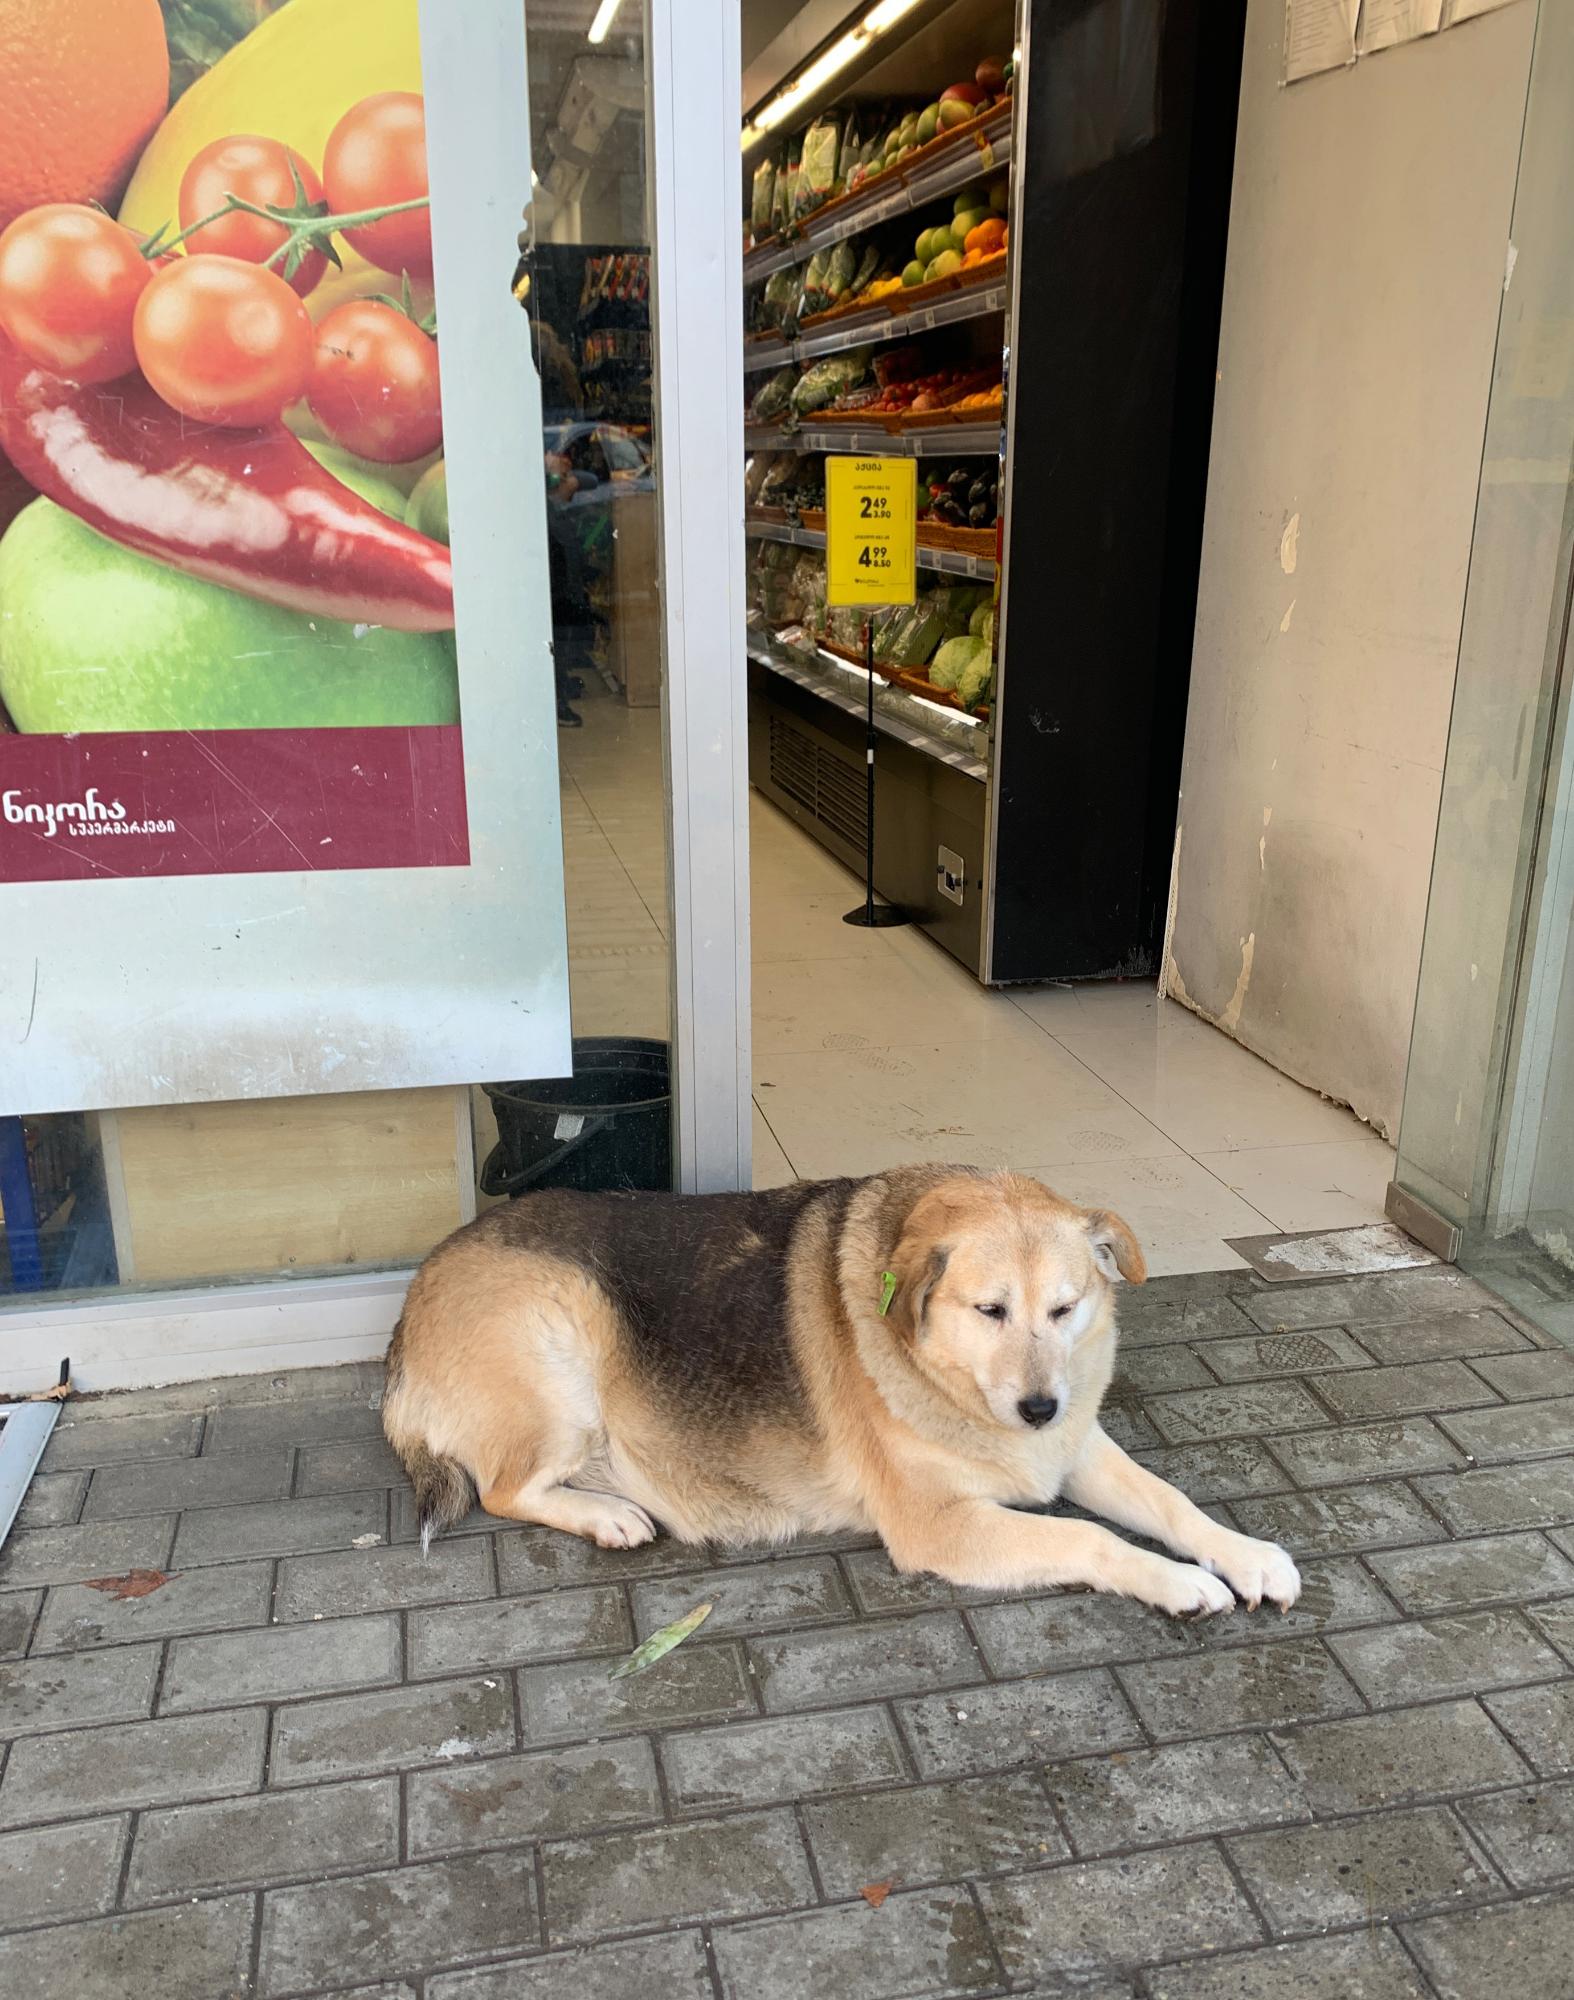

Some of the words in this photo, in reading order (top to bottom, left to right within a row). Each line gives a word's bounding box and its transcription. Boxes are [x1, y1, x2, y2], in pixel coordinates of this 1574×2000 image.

[855, 463, 882, 472] აქცია
[2, 788, 126, 837] ნიკორა
[68, 820, 176, 836] სუპერმარკეტი
